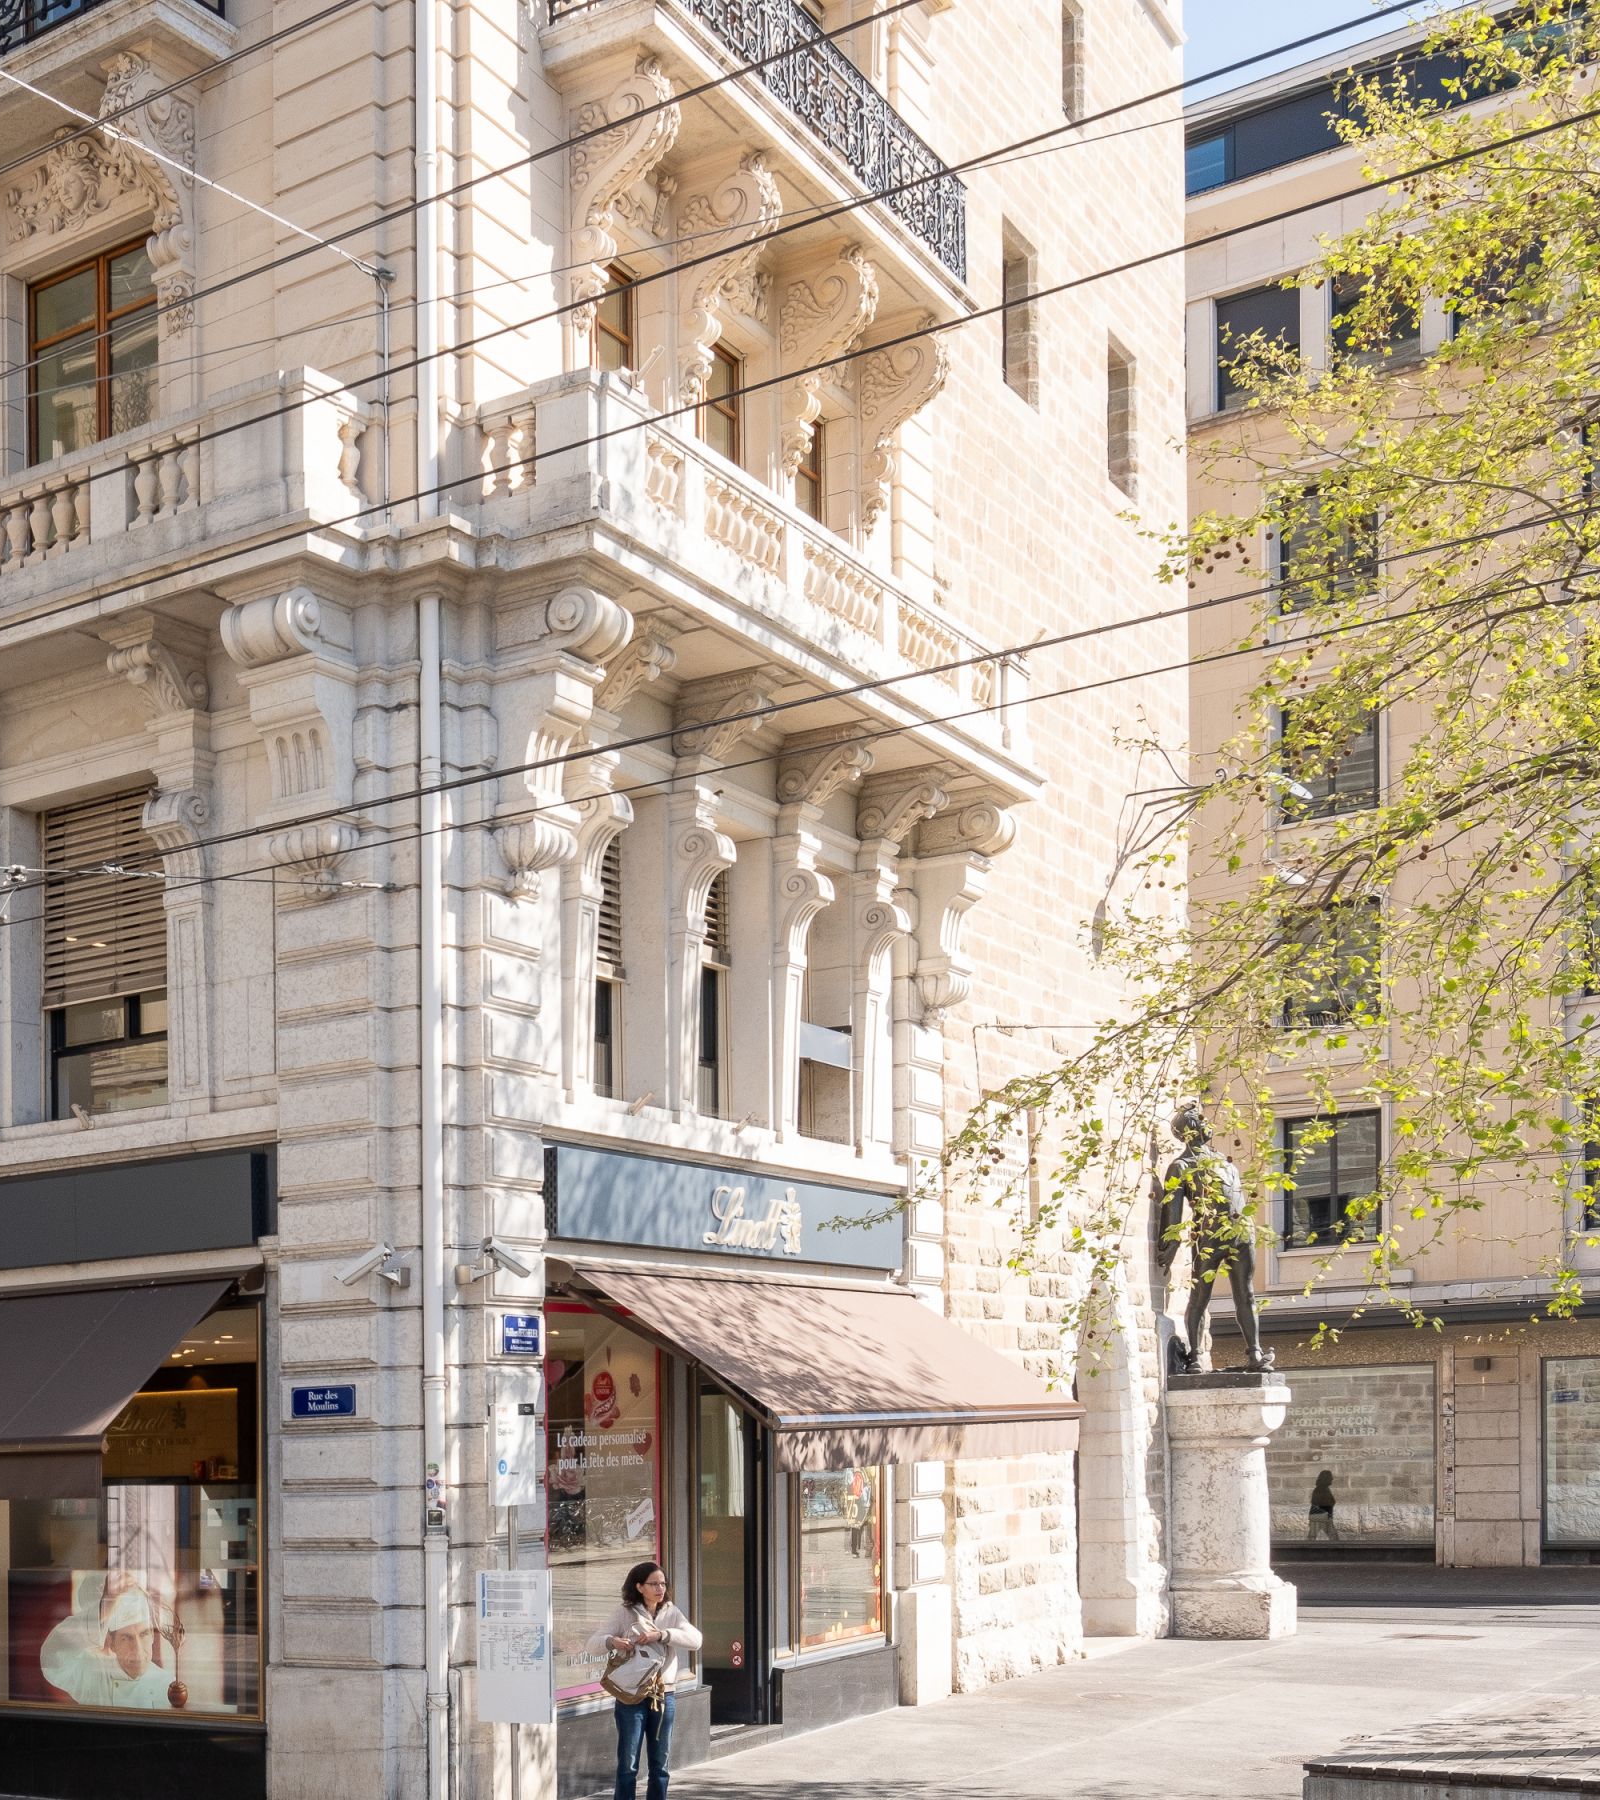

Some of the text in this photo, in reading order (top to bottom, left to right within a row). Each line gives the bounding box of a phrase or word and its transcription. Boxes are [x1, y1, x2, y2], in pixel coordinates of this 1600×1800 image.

[703, 1185, 784, 1250] Lindt
[307, 1401, 339, 1411] Moulins
[308, 1390, 338, 1401] Rue des
[557, 1429, 647, 1451] Le cadeau personnalisé
[558, 1458, 579, 1476] pour
[580, 1452, 588, 1468] la
[606, 1451, 620, 1467] des
[621, 1451, 645, 1466] mères
